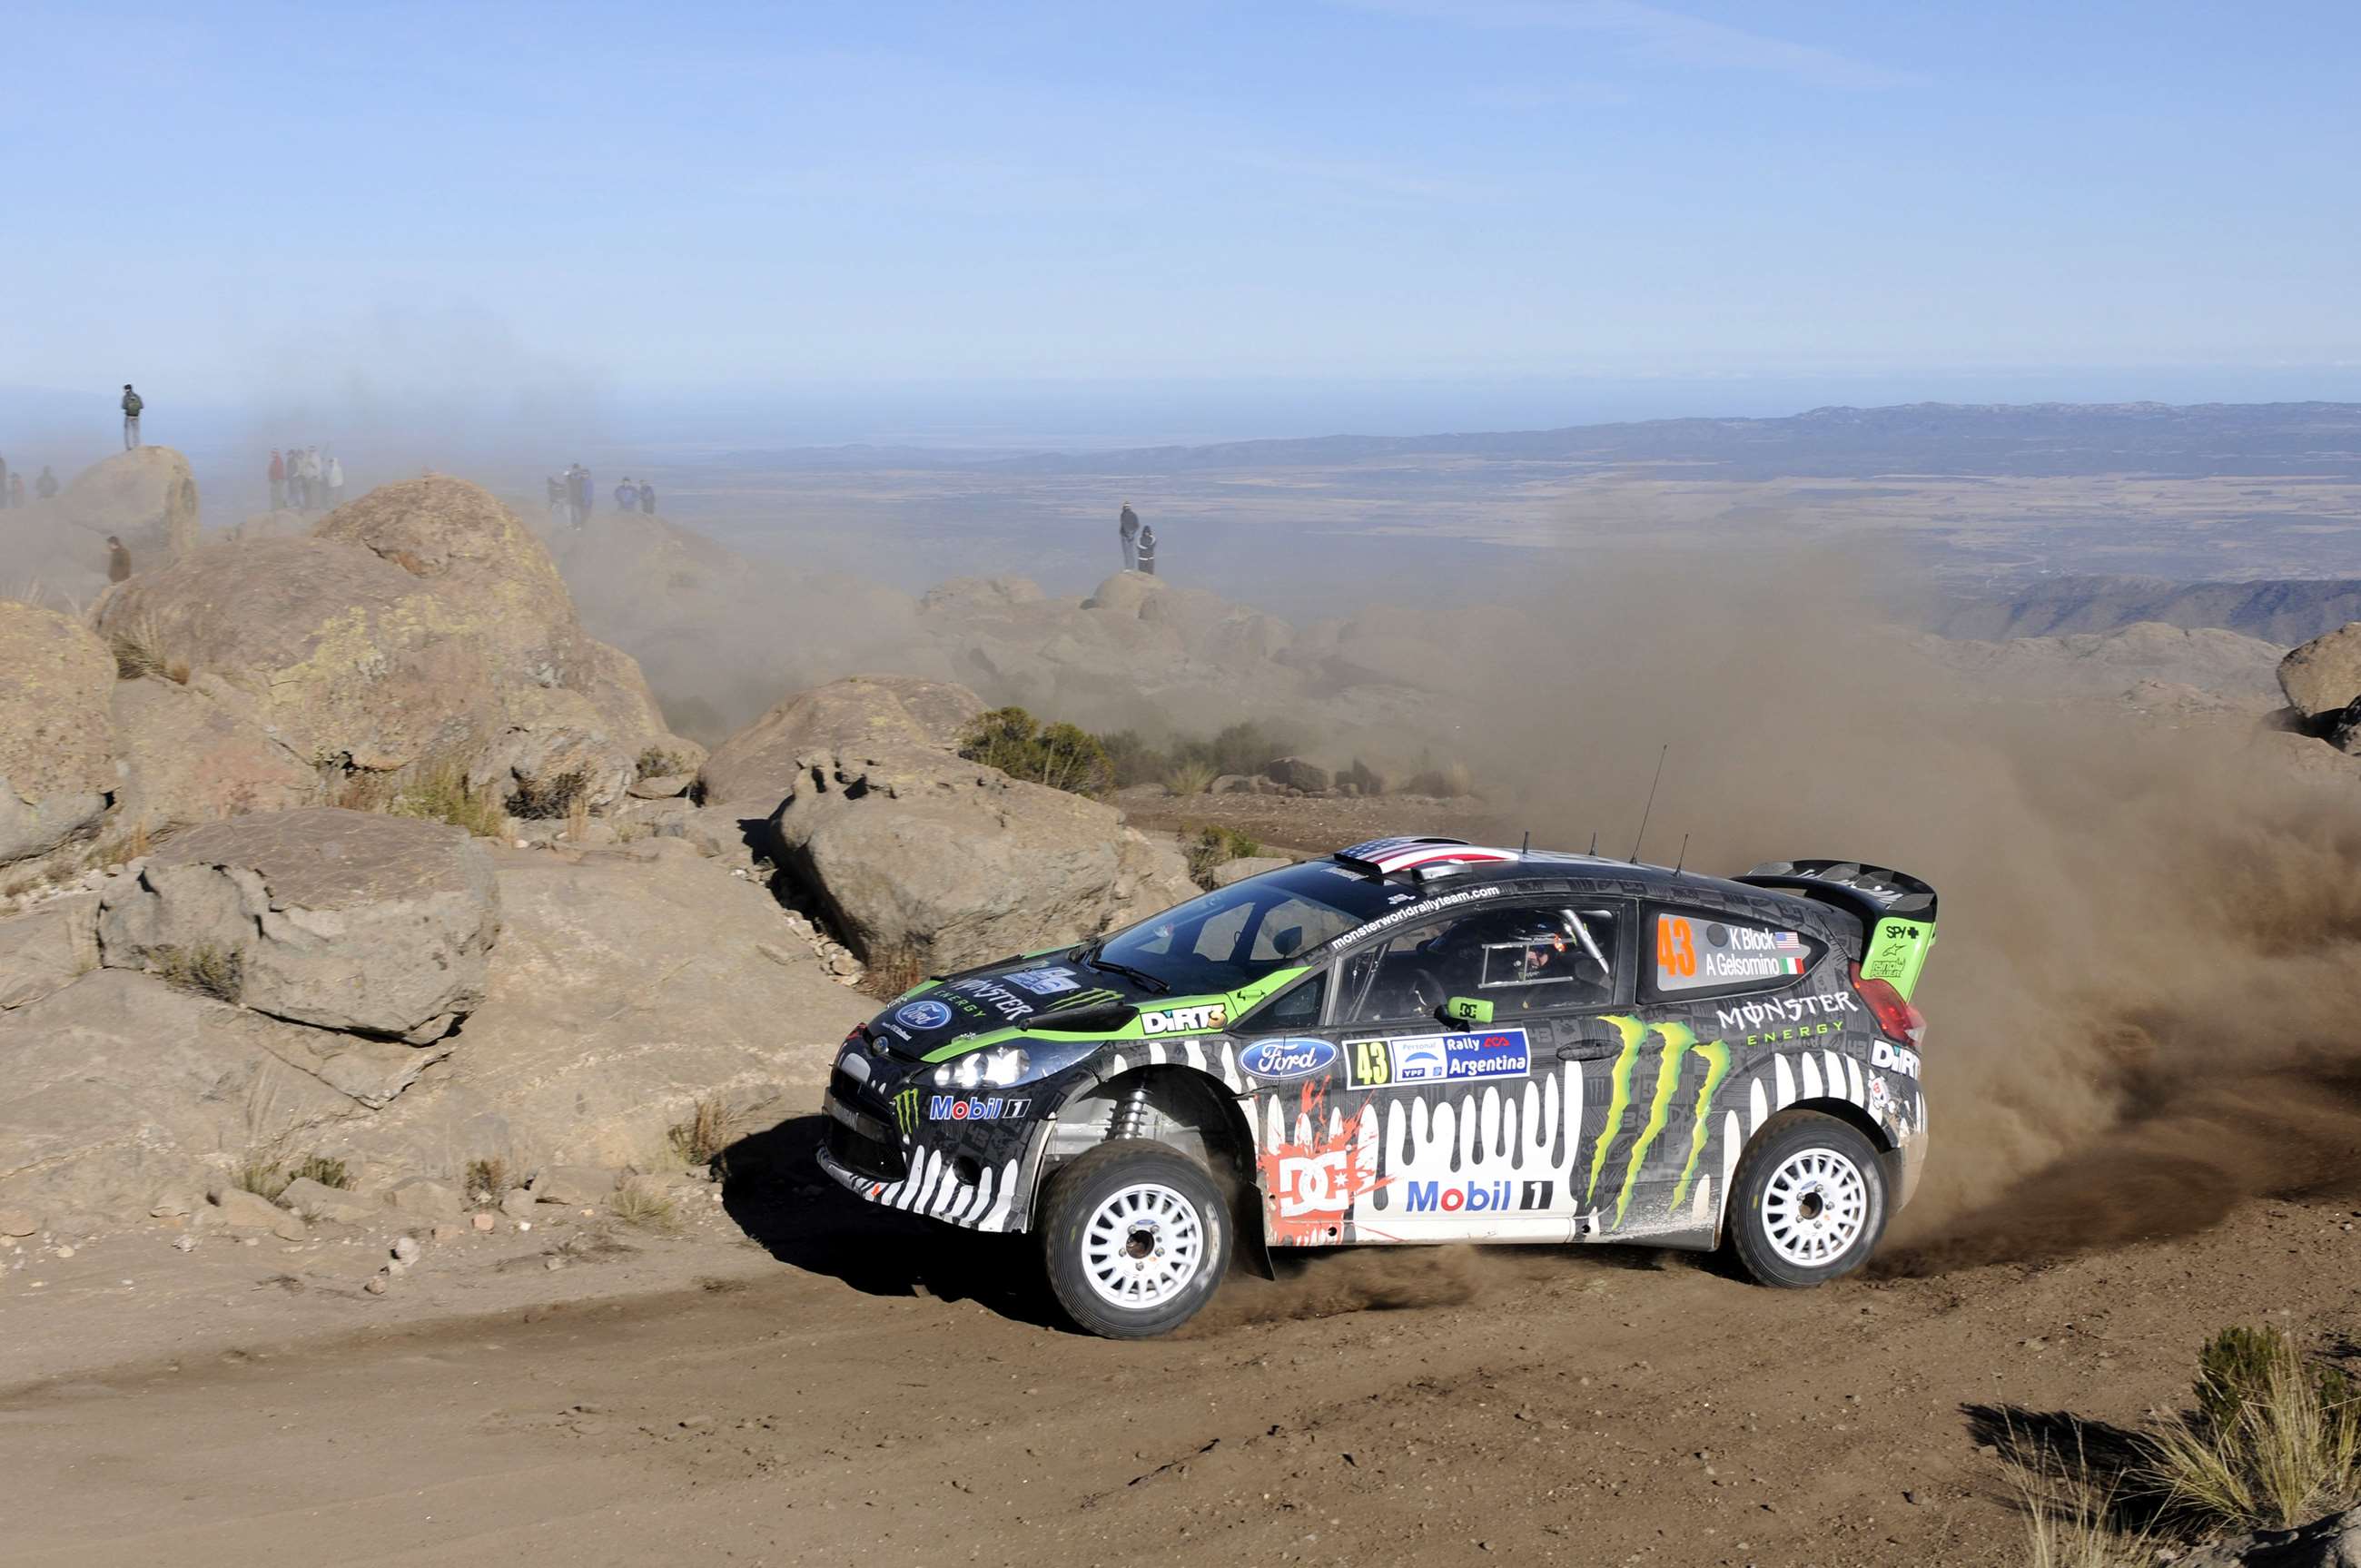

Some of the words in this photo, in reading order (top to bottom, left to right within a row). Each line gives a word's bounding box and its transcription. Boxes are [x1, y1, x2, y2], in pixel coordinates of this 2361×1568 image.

[1331, 884, 1500, 950] monsterworldrallyteam.com
[1657, 917, 1697, 978] 43
[1729, 928, 1742, 951] K
[1742, 928, 1776, 951] Block
[1706, 953, 1717, 976] A
[1716, 953, 1780, 976] Gelsomino
[934, 990, 986, 1018] ENERGY
[1460, 1002, 1478, 1019] DC
[1402, 1040, 1437, 1050] Personal
[1447, 1037, 1480, 1051] Rally
[1747, 1021, 1843, 1046] ENERGY
[1357, 1041, 1388, 1085] 43
[1404, 1069, 1424, 1077] YPF
[1449, 1055, 1526, 1076] Argentina
[930, 1095, 1003, 1120] Mobil
[1279, 1149, 1350, 1218] DC
[1406, 1180, 1512, 1212] Mobil
